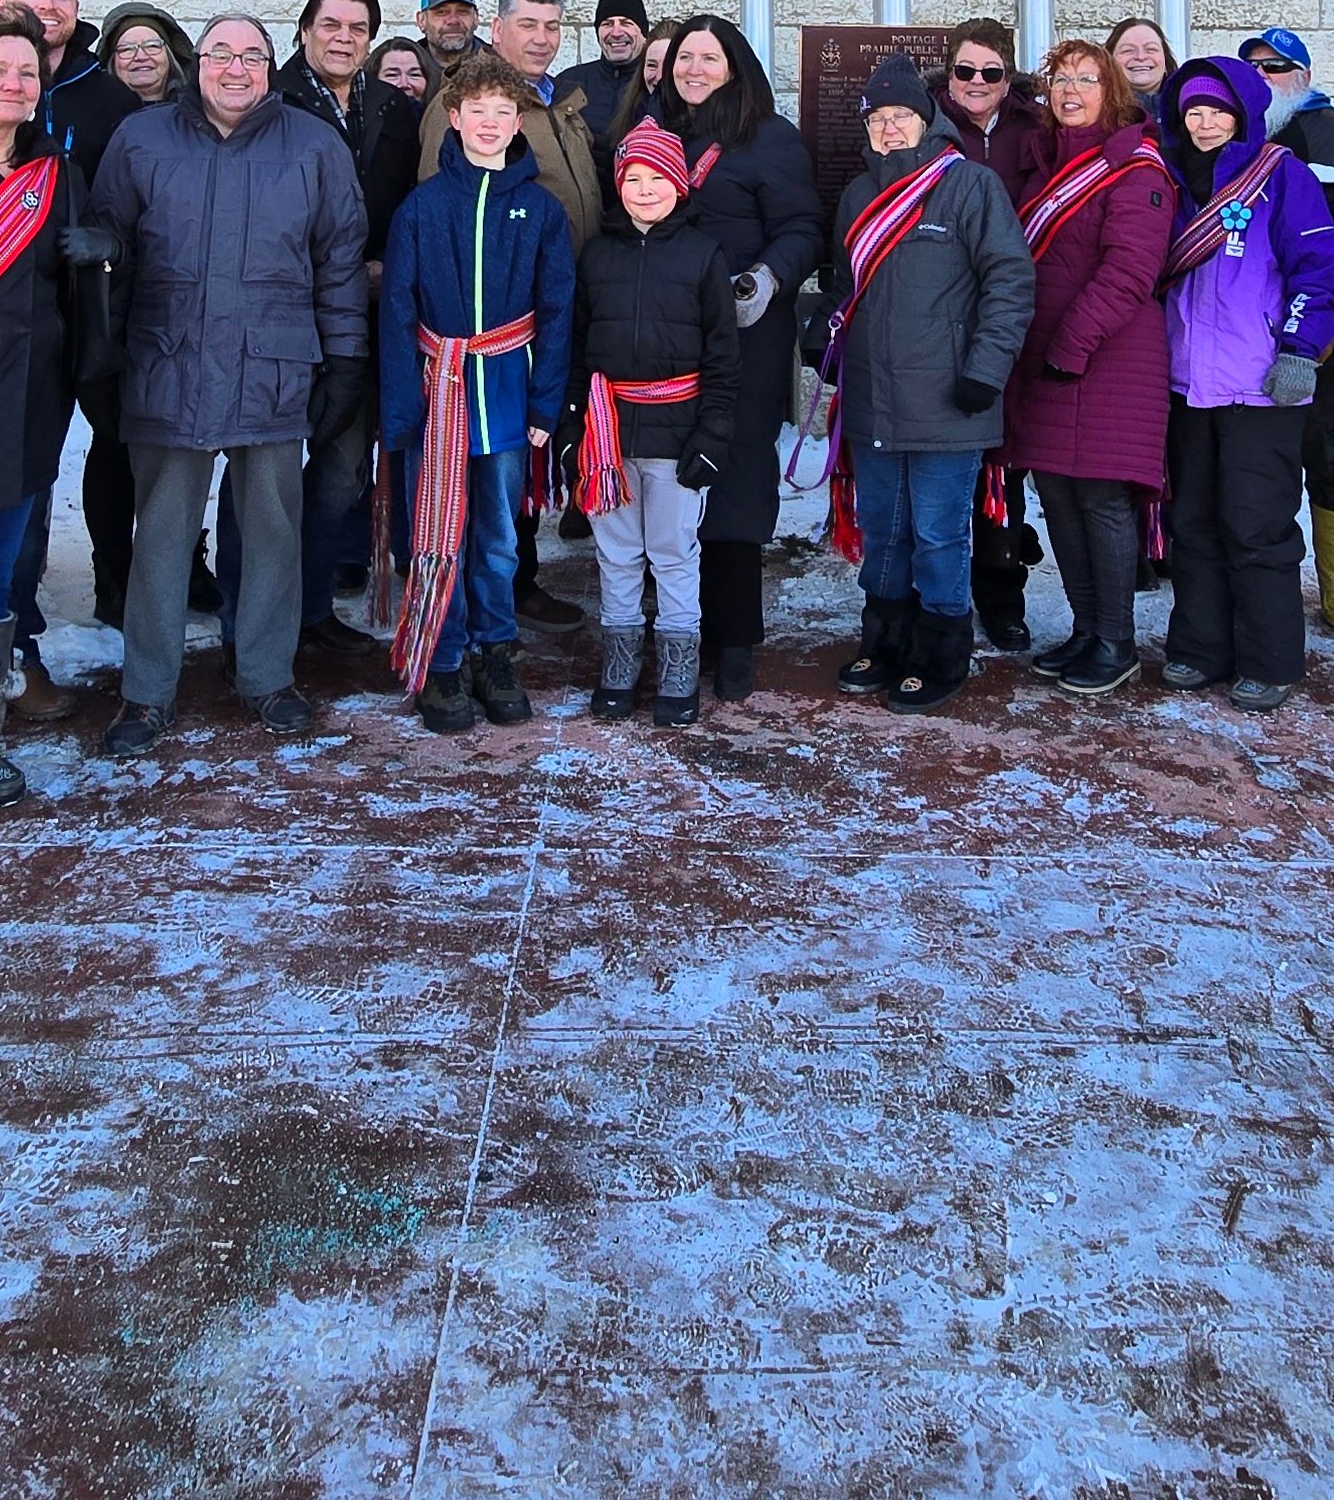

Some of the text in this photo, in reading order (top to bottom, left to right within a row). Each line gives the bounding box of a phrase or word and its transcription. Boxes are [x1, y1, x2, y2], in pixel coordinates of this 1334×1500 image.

[891, 35, 937, 44] PORTAGE
[859, 44, 899, 53] PRAIRIE
[904, 46, 939, 54] PUBLIC
